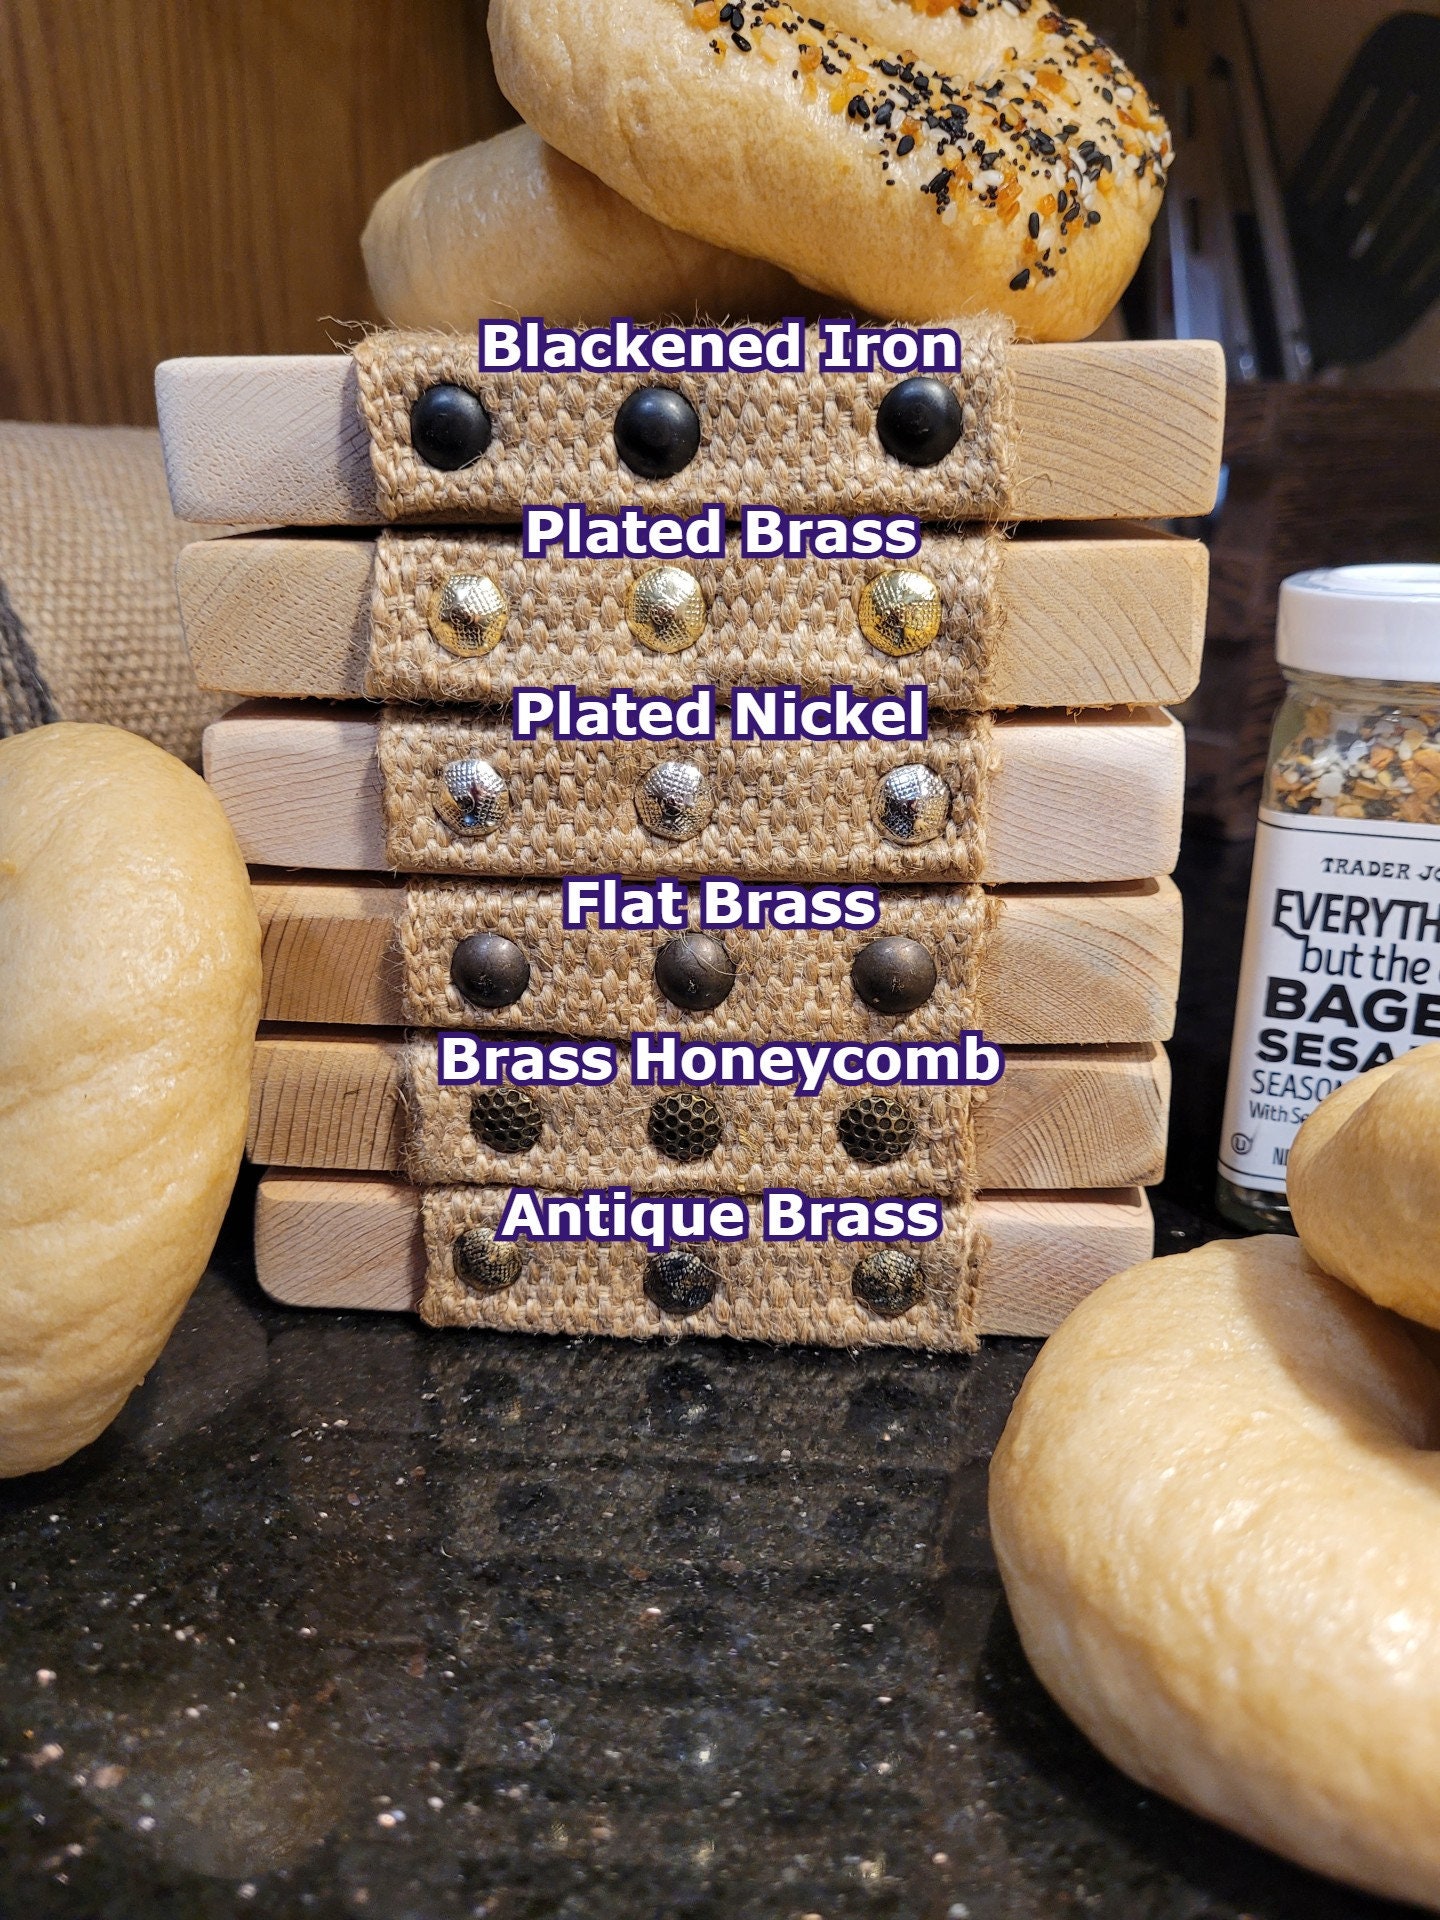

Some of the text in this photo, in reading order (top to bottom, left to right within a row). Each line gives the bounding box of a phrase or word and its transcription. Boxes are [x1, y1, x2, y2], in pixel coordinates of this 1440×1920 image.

[1321, 857, 1410, 880] TRADER
[1273, 888, 1440, 943] EVERYTH
[1299, 938, 1431, 985] but the
[1263, 976, 1440, 1037] BAGE
[1256, 1028, 1419, 1073] SESA
[1250, 1069, 1342, 1101] SEASO
[1249, 1100, 1288, 1122] With
